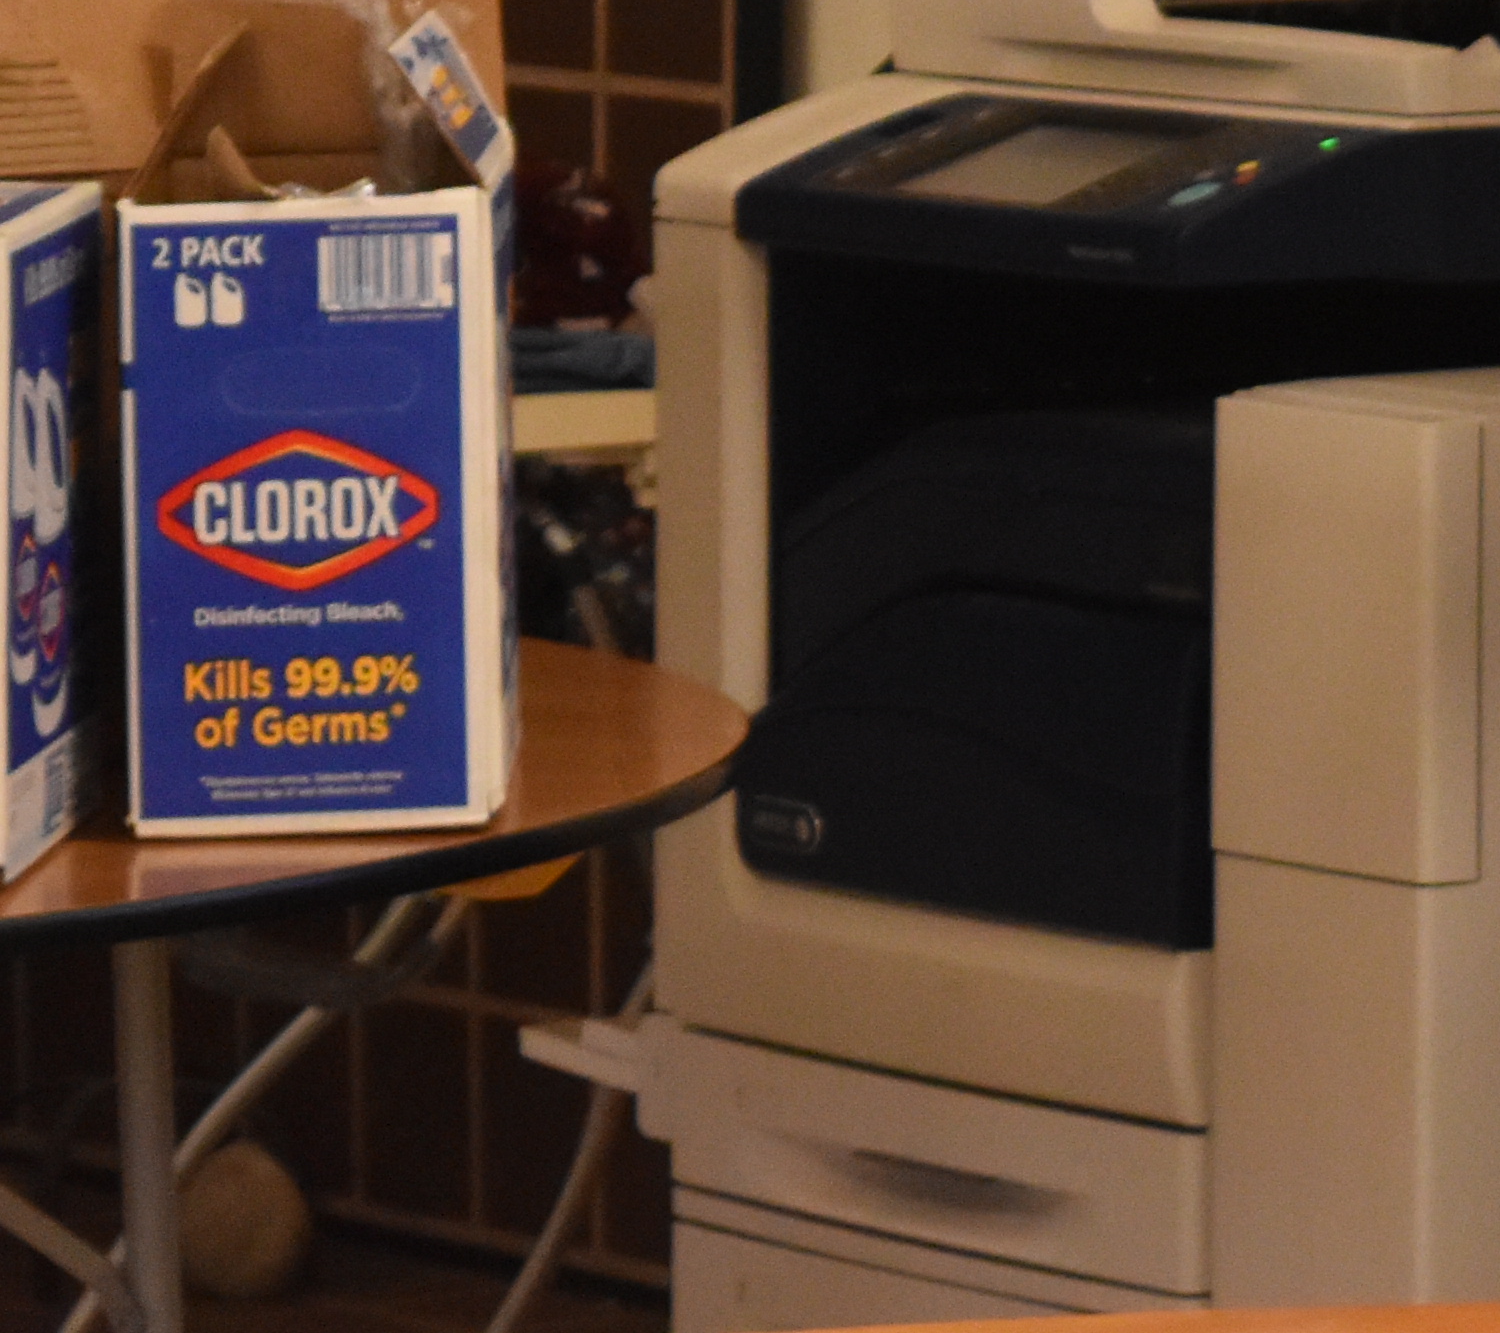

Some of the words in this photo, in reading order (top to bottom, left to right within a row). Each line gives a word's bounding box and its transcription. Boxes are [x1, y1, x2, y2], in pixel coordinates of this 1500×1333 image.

[152, 236, 172, 270] 2
[180, 234, 265, 268] PACK
[192, 475, 400, 546] CLOROX
[193, 605, 322, 629] Disinfecting
[184, 658, 273, 703] Kills
[284, 652, 421, 700] 99.9%
[194, 706, 242, 750] of
